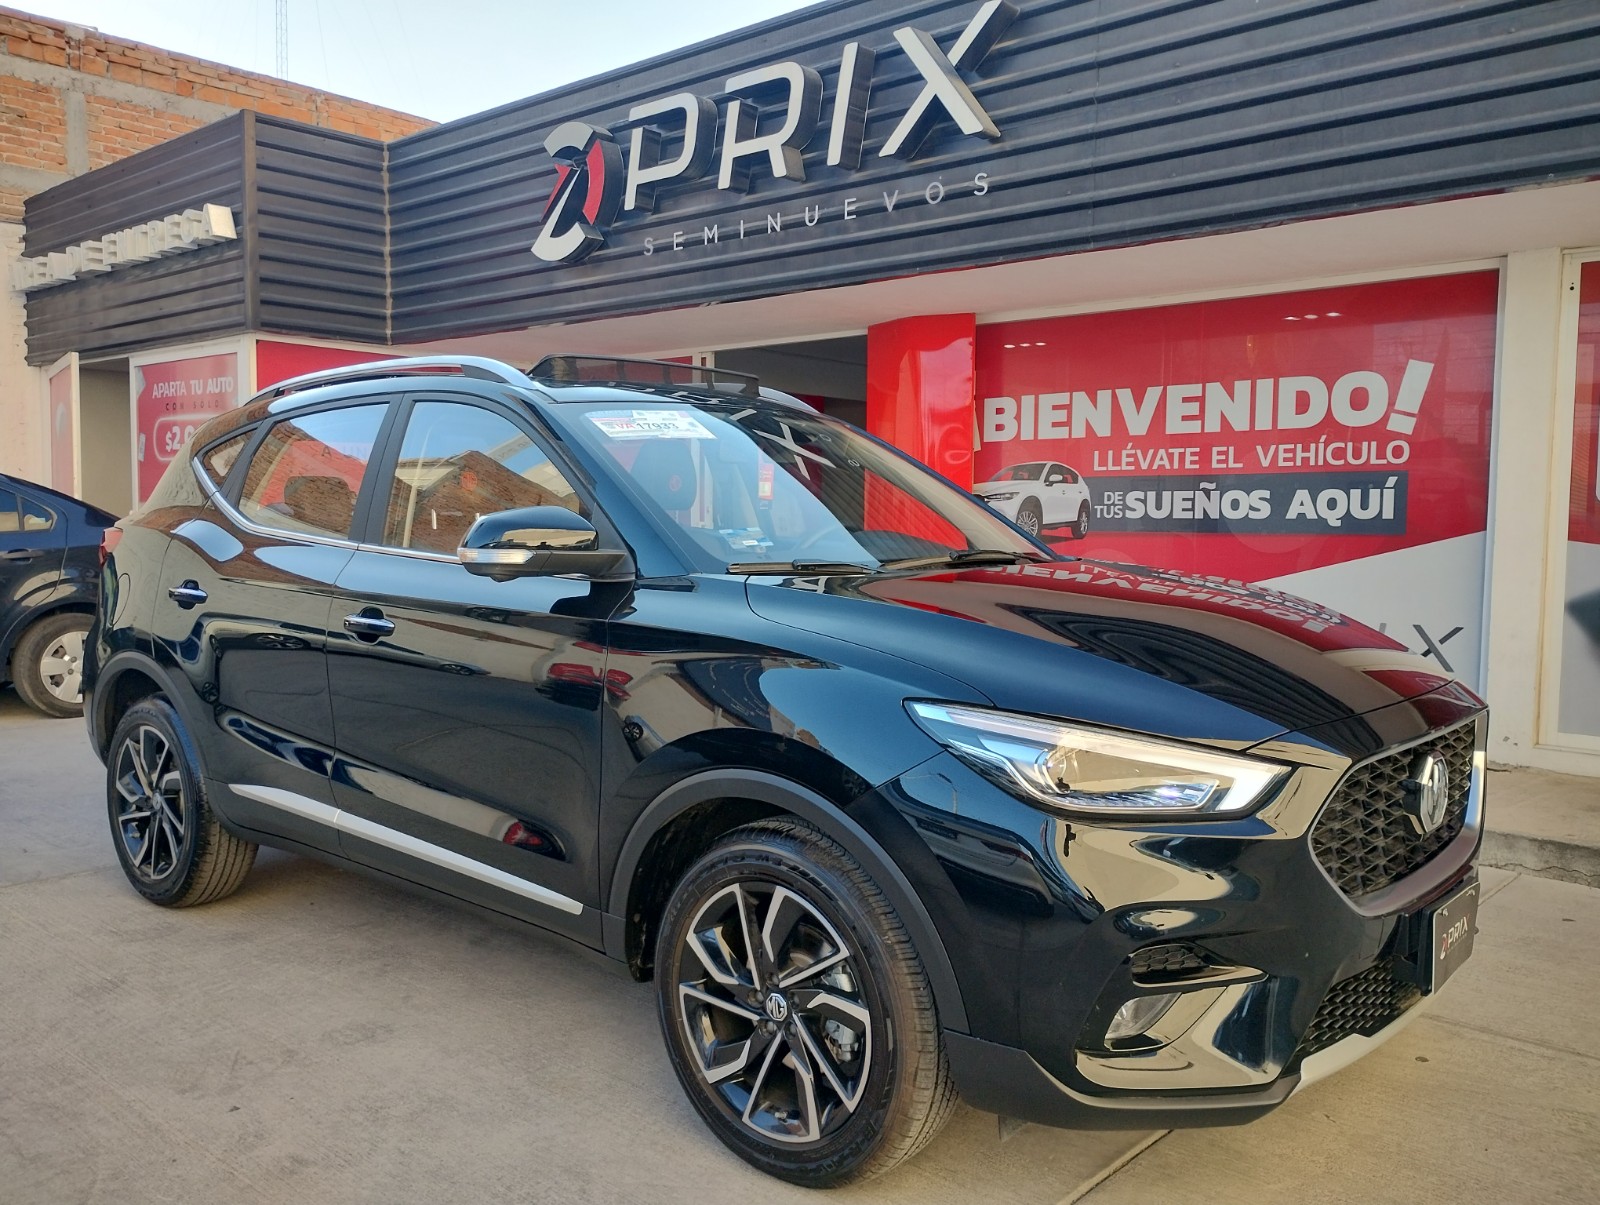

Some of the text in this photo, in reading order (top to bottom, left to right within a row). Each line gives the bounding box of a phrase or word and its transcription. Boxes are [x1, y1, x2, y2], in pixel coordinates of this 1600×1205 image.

[624, 0, 1001, 211] PRIX
[643, 172, 989, 256] SEMINUEVOS
[152, 377, 234, 399] APARTA TU AUTO
[165, 400, 219, 411] CON SOLO
[974, 359, 1435, 452] BIENVENIDO!
[1093, 434, 1411, 471] LLÉVATE EL VEHÍCULO
[1094, 505, 1124, 519] TUS
[1103, 491, 1124, 505] DE
[1125, 476, 1399, 527] SUEÑOS AQUÍ
[768, 995, 786, 1020] MG
